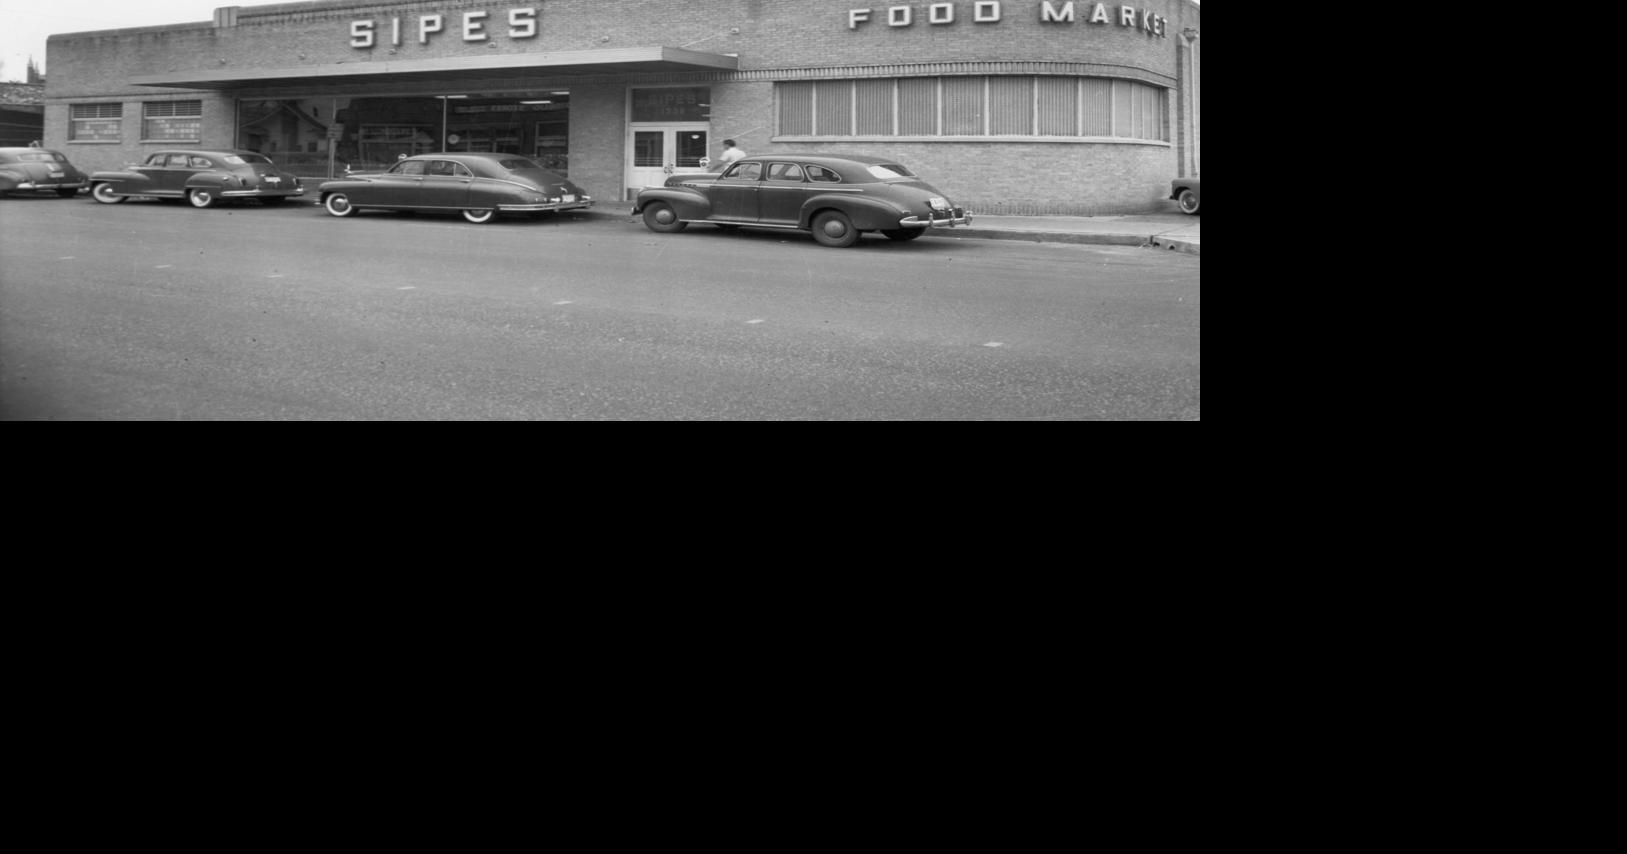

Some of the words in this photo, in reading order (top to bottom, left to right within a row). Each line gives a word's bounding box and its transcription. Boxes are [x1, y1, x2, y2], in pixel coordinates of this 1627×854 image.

[351, 7, 537, 48] SIPES
[849, 0, 1001, 29] FOOD
[1040, 0, 1168, 37] MARKET
